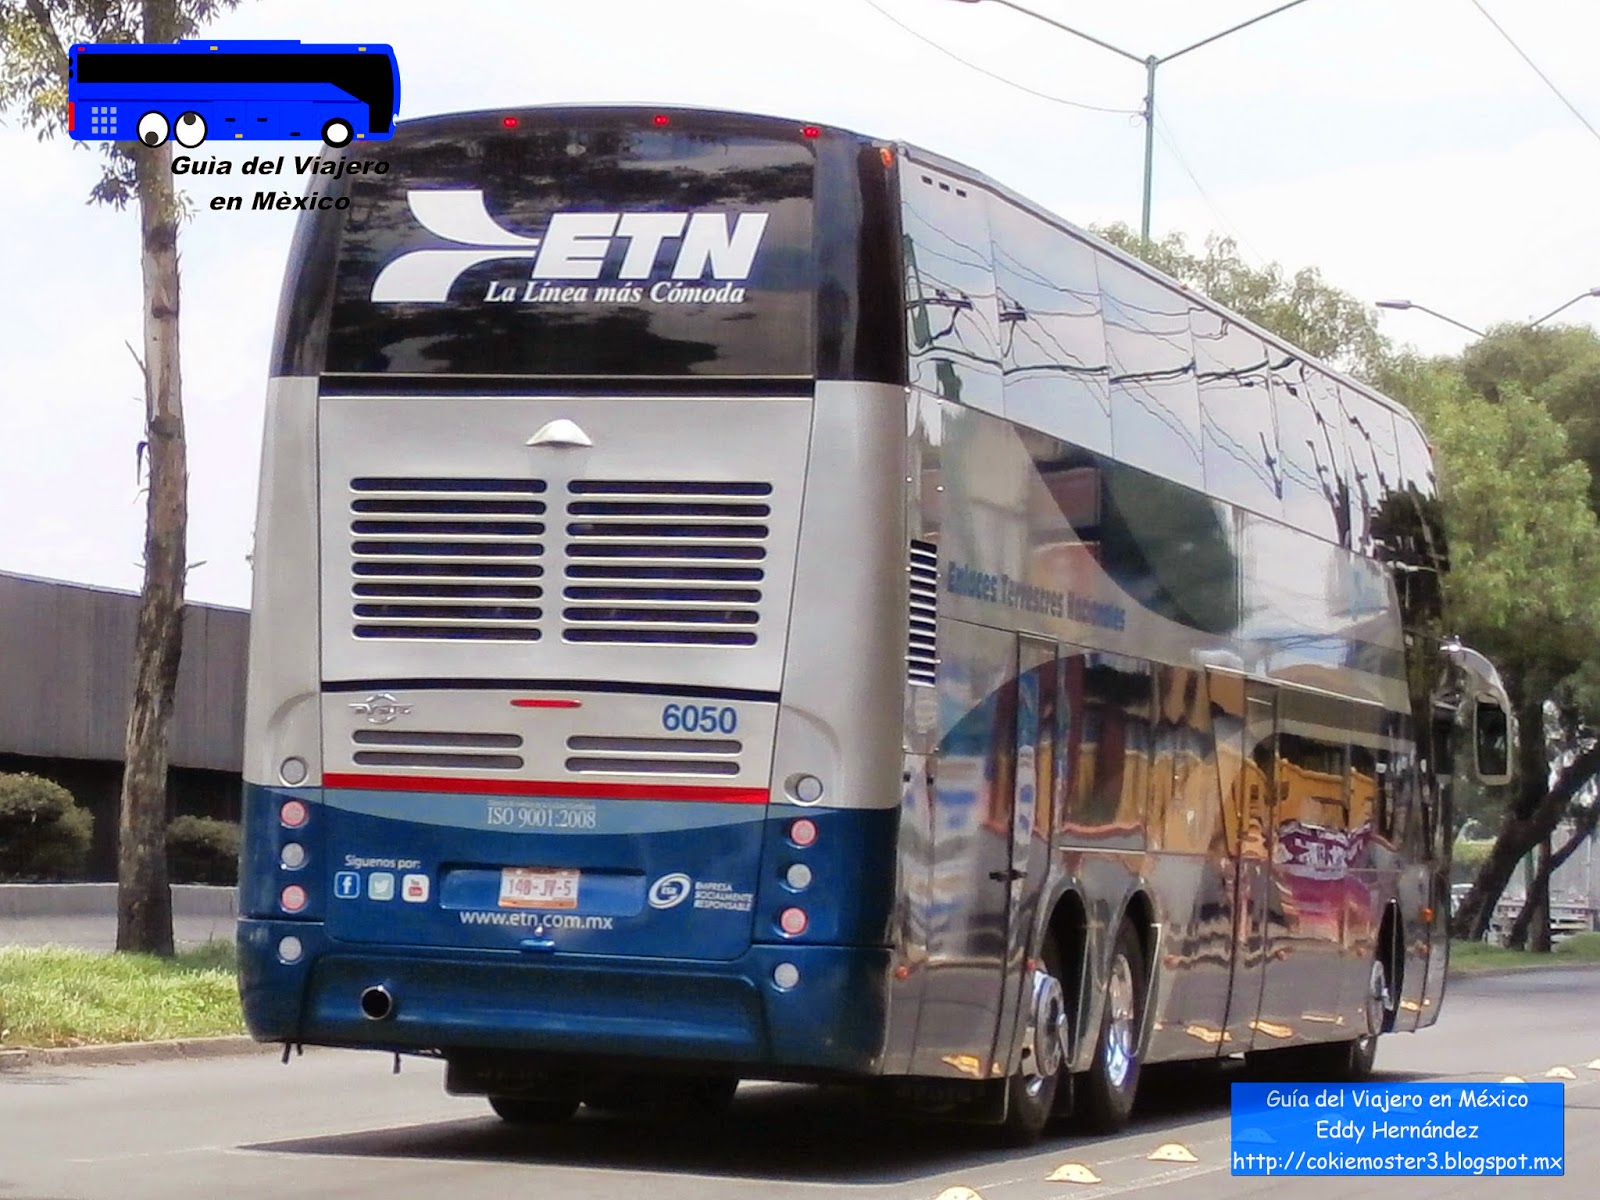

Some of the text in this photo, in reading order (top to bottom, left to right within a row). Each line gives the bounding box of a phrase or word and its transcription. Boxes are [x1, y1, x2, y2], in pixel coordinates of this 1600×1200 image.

[532, 213, 769, 279] ETN
[484, 280, 746, 304] La Línea más Cómoda
[662, 703, 738, 734] 6050
[487, 806, 597, 829] ISO 9001:2008
[694, 882, 733, 891] EMPRESA
[694, 891, 754, 902] SOCIALMENTE
[693, 900, 753, 912] RESPONSABLE
[459, 911, 613, 930] www.etn.com.mx
